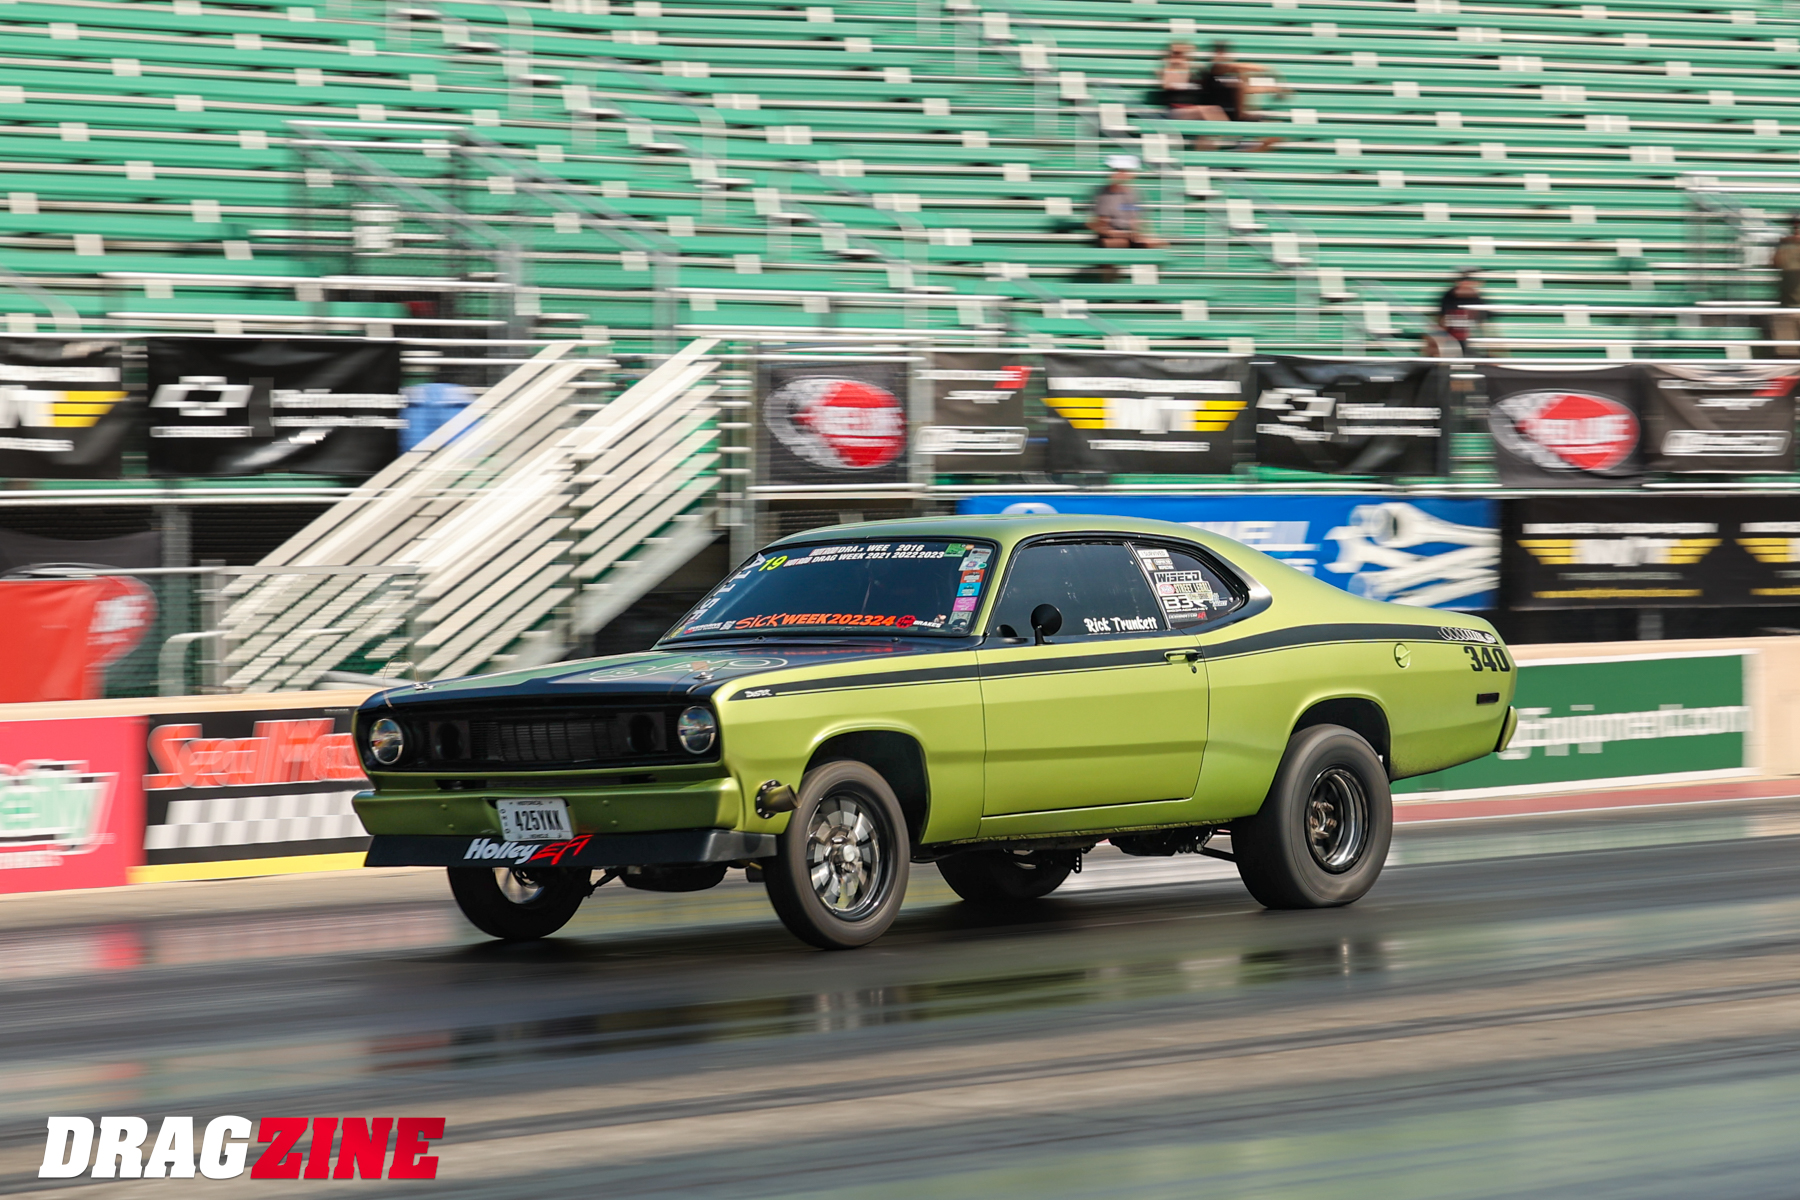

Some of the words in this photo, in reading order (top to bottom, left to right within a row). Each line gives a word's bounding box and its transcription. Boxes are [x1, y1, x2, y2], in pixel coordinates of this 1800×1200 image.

[895, 544, 925, 552] 2016
[758, 555, 788, 572] 19
[811, 554, 838, 564] DRAG
[838, 552, 866, 561] WEEK
[865, 551, 891, 560] 2021
[891, 551, 918, 559] 2022
[917, 551, 945, 559] 2023
[1083, 617, 1111, 633] Rick
[1463, 646, 1511, 672] 340
[463, 838, 543, 865] Holley
[526, 834, 594, 866] EFI
